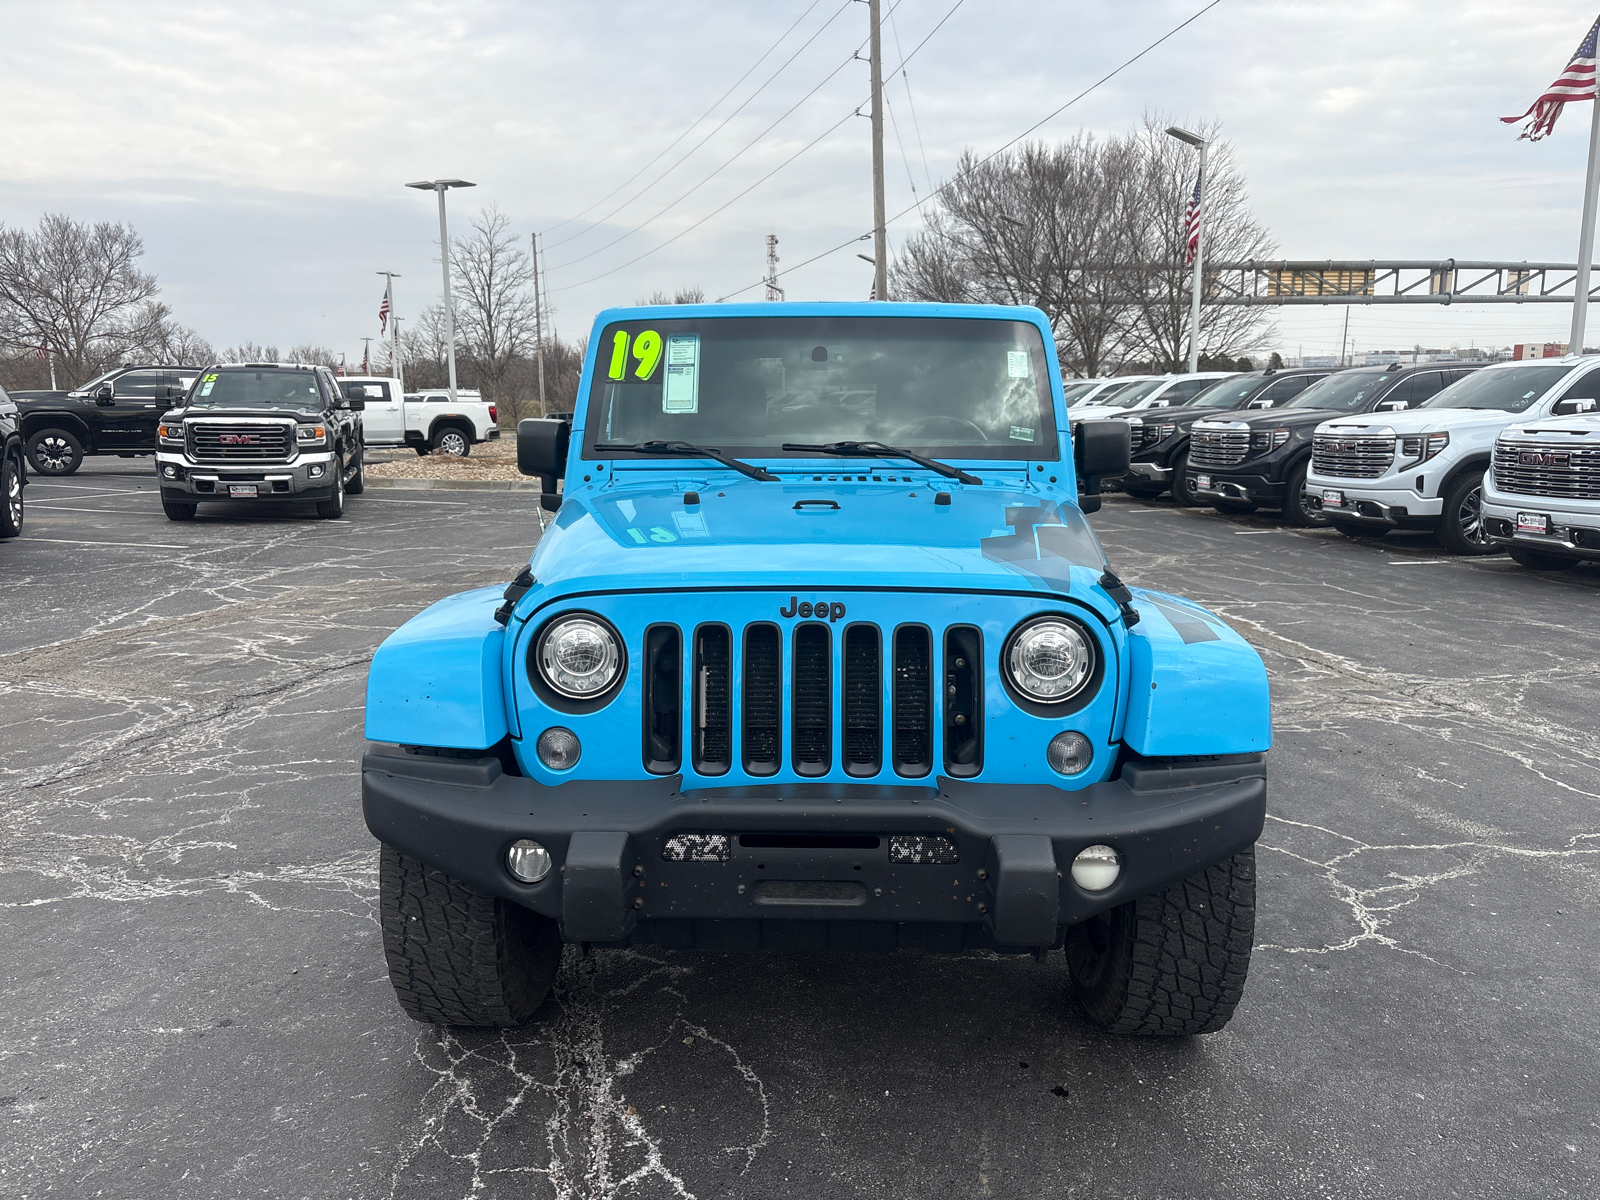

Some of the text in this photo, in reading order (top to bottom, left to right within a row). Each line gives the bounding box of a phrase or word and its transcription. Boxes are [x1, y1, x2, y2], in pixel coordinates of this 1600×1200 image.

[608, 330, 664, 381] 19
[202, 374, 219, 382] 15
[219, 434, 260, 444] GMC
[1324, 443, 1355, 453] GMC
[1519, 452, 1569, 466] GMC
[780, 596, 846, 622] Jeep
